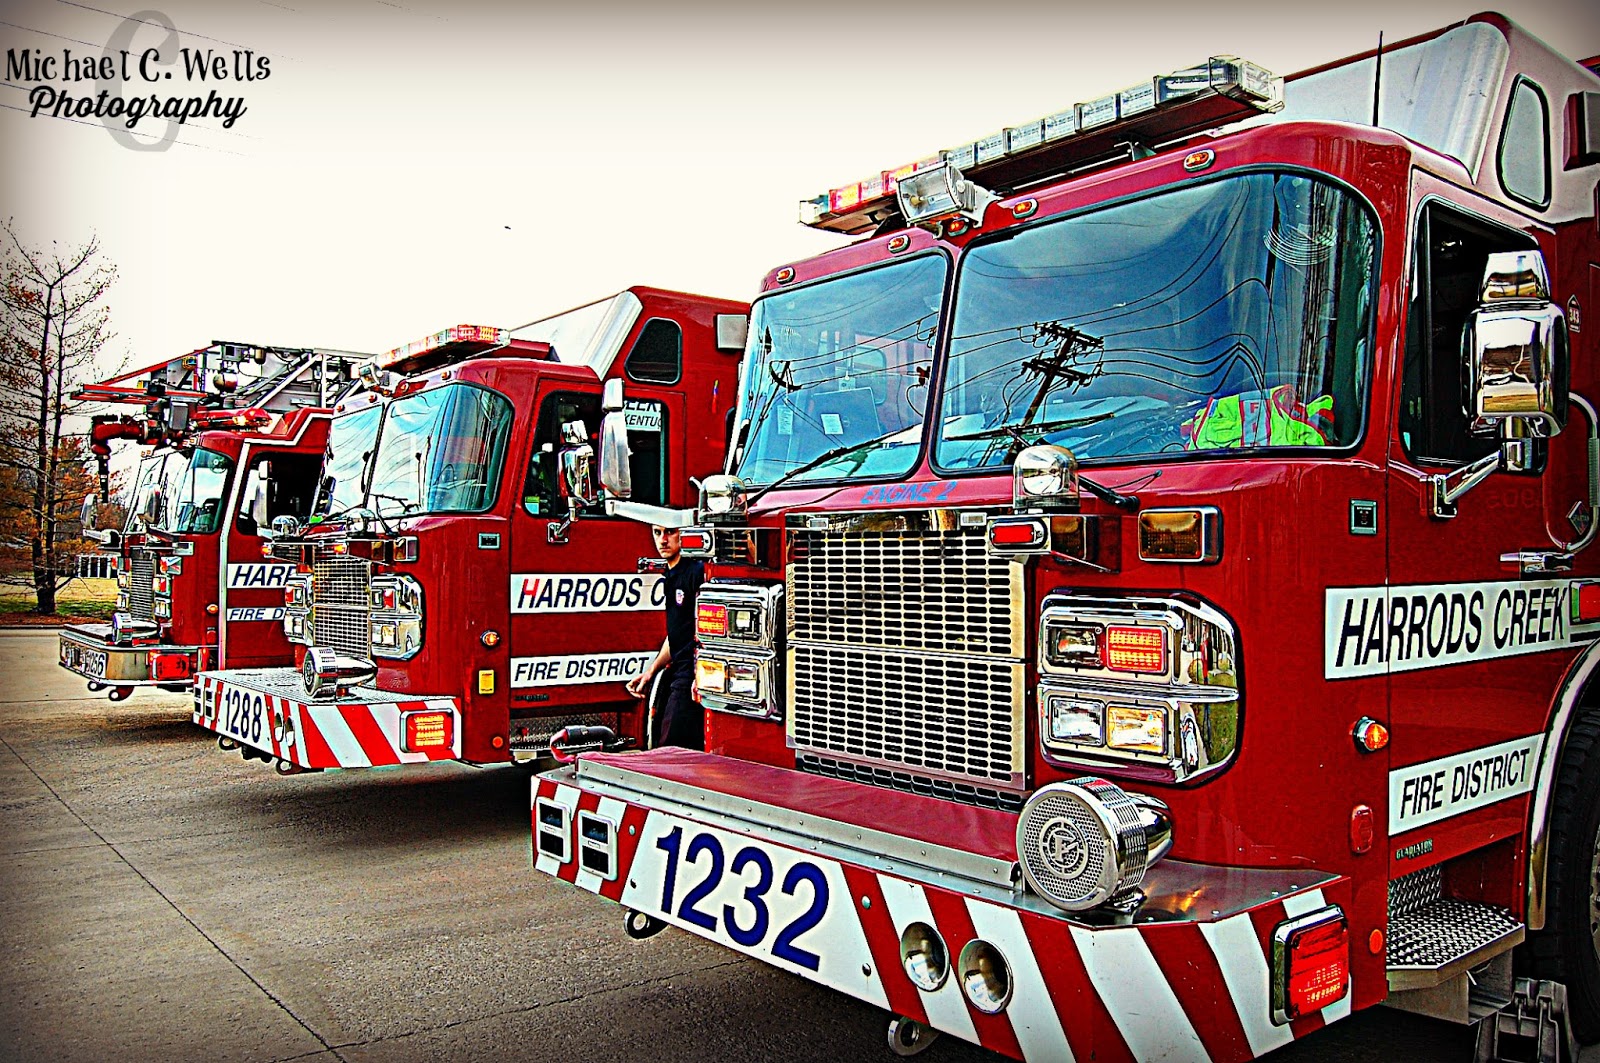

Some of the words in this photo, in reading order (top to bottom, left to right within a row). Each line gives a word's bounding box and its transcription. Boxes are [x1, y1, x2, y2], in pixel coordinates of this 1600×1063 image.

[861, 481, 938, 505] ENGINE
[936, 480, 959, 501] 2
[229, 608, 266, 621] FIRE
[517, 578, 643, 609] HARRODS
[1335, 590, 1485, 668] HARRODS
[1493, 587, 1569, 651] CREEK
[514, 661, 561, 682] FIRE
[565, 656, 650, 679] DISTRICT
[225, 687, 263, 744] 1288
[1400, 770, 1447, 820] FIRE
[1451, 748, 1531, 804] DISTRICT
[656, 825, 830, 973] 1232
